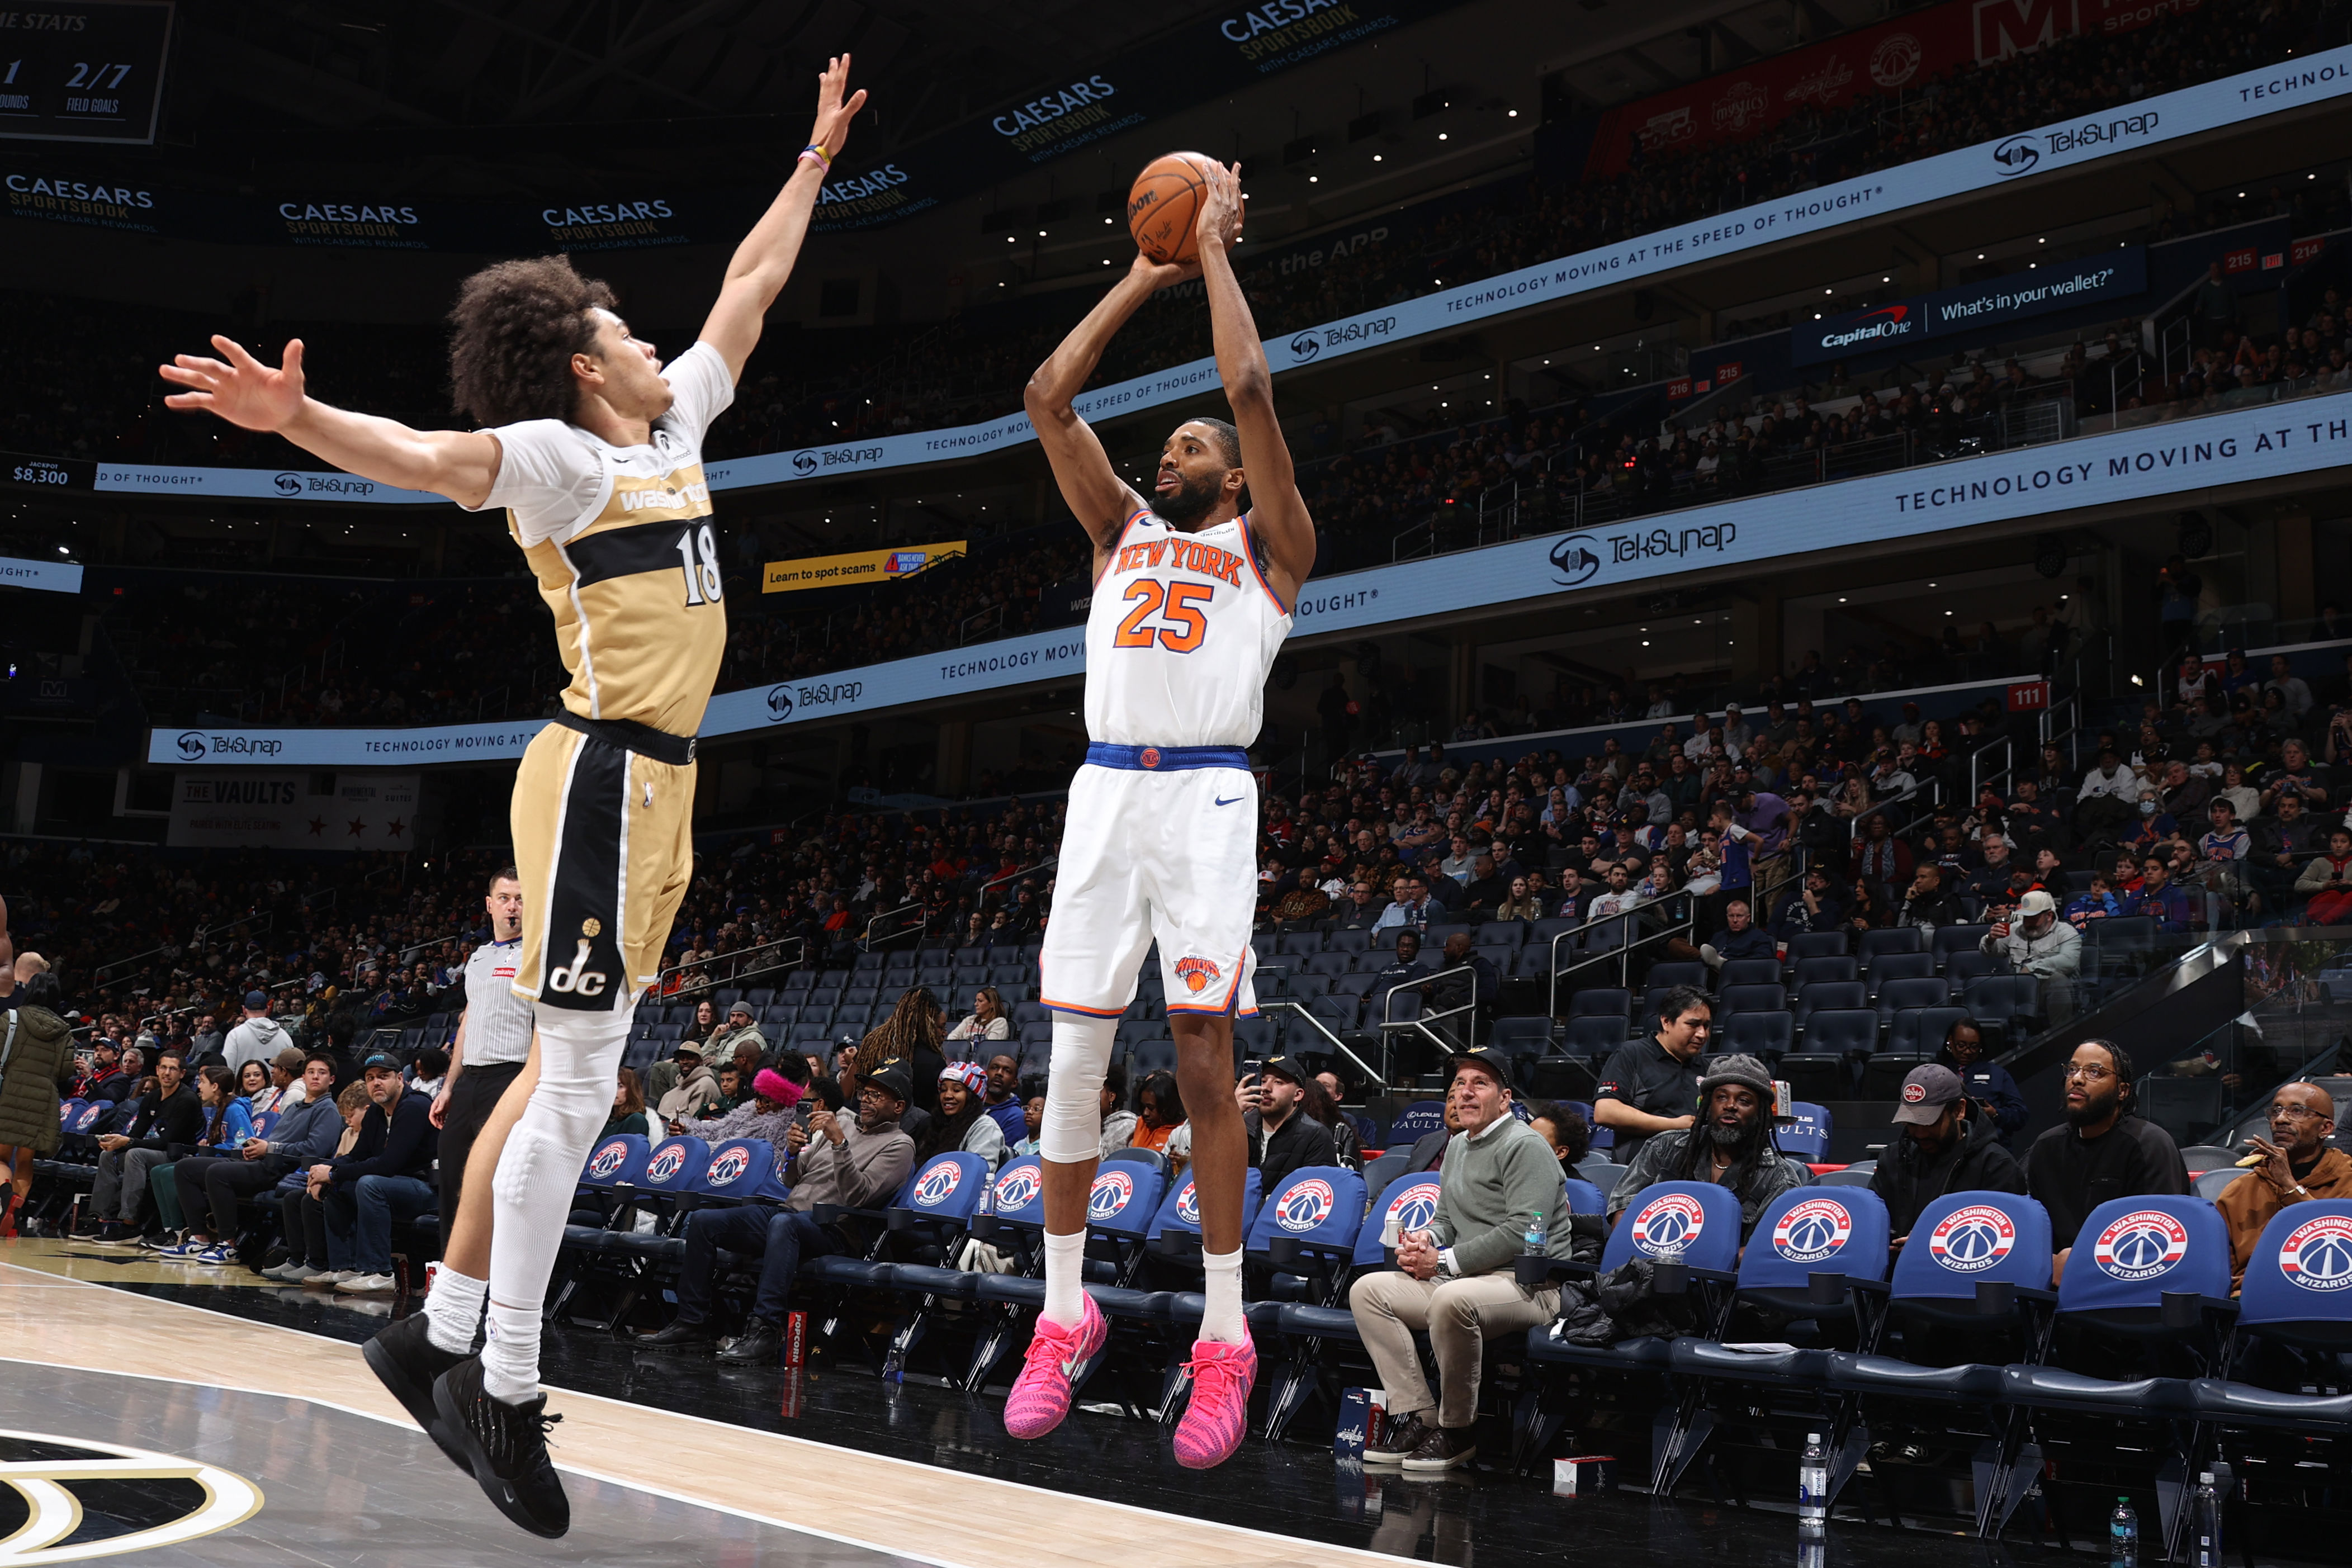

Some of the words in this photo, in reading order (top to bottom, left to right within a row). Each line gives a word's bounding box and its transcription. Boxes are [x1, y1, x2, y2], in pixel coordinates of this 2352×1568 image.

[22, 13, 87, 32] STATS
[1220, 0, 1338, 42] CAESA
[1239, 4, 1359, 60] SPORTSBOOK
[1257, 57, 1286, 73] WITH
[1288, 37, 1338, 64] CAESARS
[3, 59, 22, 84] 1
[65, 63, 132, 89] 2/7
[67, 97, 88, 112] FIELD
[91, 99, 119, 113] GOALS
[992, 74, 1116, 137] CAESARS
[2045, 112, 2159, 154] TekSynap
[2240, 63, 2350, 102] TECHNOL
[1011, 103, 1113, 151] SPORTSBOOK
[1029, 146, 1053, 163] WITH
[1054, 131, 1094, 153] CAESARS
[6, 174, 154, 209] CAESARS
[814, 163, 909, 205] AESARS
[10, 192, 129, 219] SPORTSBOOK
[280, 203, 419, 225] CAESARS
[542, 200, 673, 228] CAESARS
[810, 190, 908, 220] SPORTSBOOK
[12, 208, 43, 220] WITH
[46, 212, 98, 226] CAESARS
[812, 220, 841, 233] WITH
[846, 211, 895, 229] CAESARS
[286, 221, 399, 238] SPORTSBOOK
[551, 220, 659, 241] SPORTSBOOK
[292, 236, 321, 245] WITH
[324, 237, 373, 247] CAESARS
[560, 241, 588, 252] WITH
[590, 238, 636, 250] CAESARS
[2294, 243, 2318, 260] 214
[1280, 248, 1323, 276] the
[2228, 253, 2252, 269] 215
[1324, 316, 1395, 347] TekSynap
[1447, 276, 1549, 313] TECHNOLOGY
[1555, 257, 1621, 284] MOVING
[1627, 249, 1647, 264] AT
[1653, 239, 1684, 257] THE
[1692, 224, 1746, 247] SPEED
[1754, 214, 1777, 230] OF
[1941, 294, 1994, 321] What's
[1996, 293, 2011, 309] in
[2012, 284, 2049, 311] your
[1719, 367, 1738, 380] 215
[1096, 392, 1131, 410] SPEED
[1136, 386, 1152, 399] OF
[1670, 383, 1688, 396] 216
[822, 447, 883, 467] TekSynap
[926, 428, 1004, 450] TECHNOLOGY
[1007, 420, 1033, 434] MOV
[13, 466, 68, 485] $8,300
[29, 461, 59, 470] JACKPOT
[115, 473, 131, 482] OF
[307, 478, 374, 495] TekSynap
[1608, 523, 1736, 563] TekSynap
[1896, 462, 2094, 512] TECHNOLOGY
[2109, 438, 2237, 476] MOVING
[2255, 429, 2291, 453] AT
[674, 522, 722, 607] 18
[1114, 539, 1168, 577] NEW
[1171, 537, 1243, 587] YORK
[770, 568, 798, 584] Learn
[801, 569, 812, 580] to
[814, 566, 839, 582] spot
[841, 563, 876, 576] scams
[1113, 578, 1215, 654] 25
[941, 650, 1039, 680] TECHNOLOGY
[798, 681, 862, 708] TekSynap
[2015, 688, 2039, 705] 111
[211, 737, 281, 756] TekSynap
[366, 740, 450, 752] TECHNOLOGY
[455, 735, 504, 748] MOVING
[509, 734, 524, 745] AT
[186, 786, 209, 798] THE
[214, 781, 296, 805] VAULTS
[190, 819, 214, 829] PAIRED
[215, 819, 232, 830] WITH
[233, 819, 251, 830] ELITE
[253, 820, 281, 830] SEATING
[1175, 956, 1221, 978] KNICKS
[1392, 1120, 1447, 1129] VAULT
[927, 1161, 960, 1176] WASHINGTON
[1006, 1166, 1041, 1180] WASHINGTON
[711, 1176, 733, 1185] WIZARDS
[1095, 1172, 1130, 1190] WASHINGTON
[1291, 1181, 1331, 1198] WASHINGTON
[918, 1196, 944, 1204] WIZARDS
[996, 1201, 1024, 1210] WIZARDS
[1648, 1196, 1699, 1213] WASHINGTON
[1788, 1201, 1845, 1220] WASHINGTON
[1280, 1219, 1314, 1230] WIZARDS
[1947, 1208, 2008, 1227] WASHINGTON
[2110, 1214, 2178, 1233] WASHINGTON
[1640, 1240, 1683, 1255] WIZARDS
[1783, 1247, 1830, 1262] WIZARDS
[1942, 1256, 1993, 1270] WIZARDS
[2108, 1263, 2166, 1278] WIZARDS
[792, 1314, 801, 1363] POPCORN
